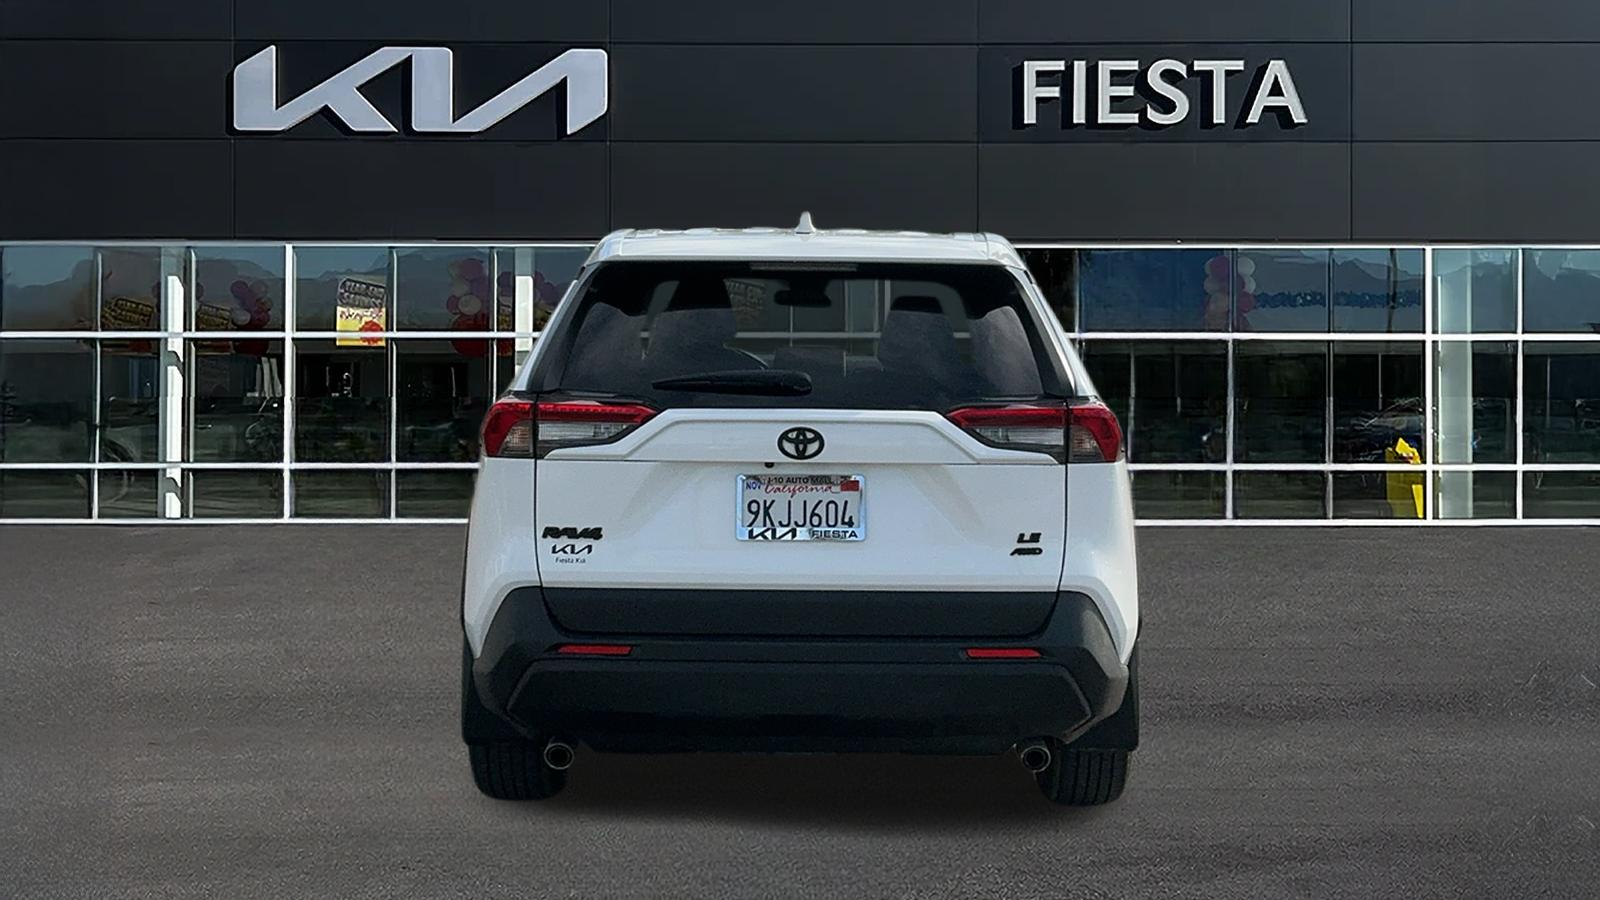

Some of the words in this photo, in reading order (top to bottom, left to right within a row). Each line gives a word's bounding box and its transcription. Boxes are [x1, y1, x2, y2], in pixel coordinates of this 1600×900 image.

[1022, 58, 1308, 124] FIESTA
[785, 476, 809, 484] AUTO
[764, 484, 833, 498] California
[747, 499, 855, 528] 9KJJ604
[811, 529, 859, 539] FIESTA
